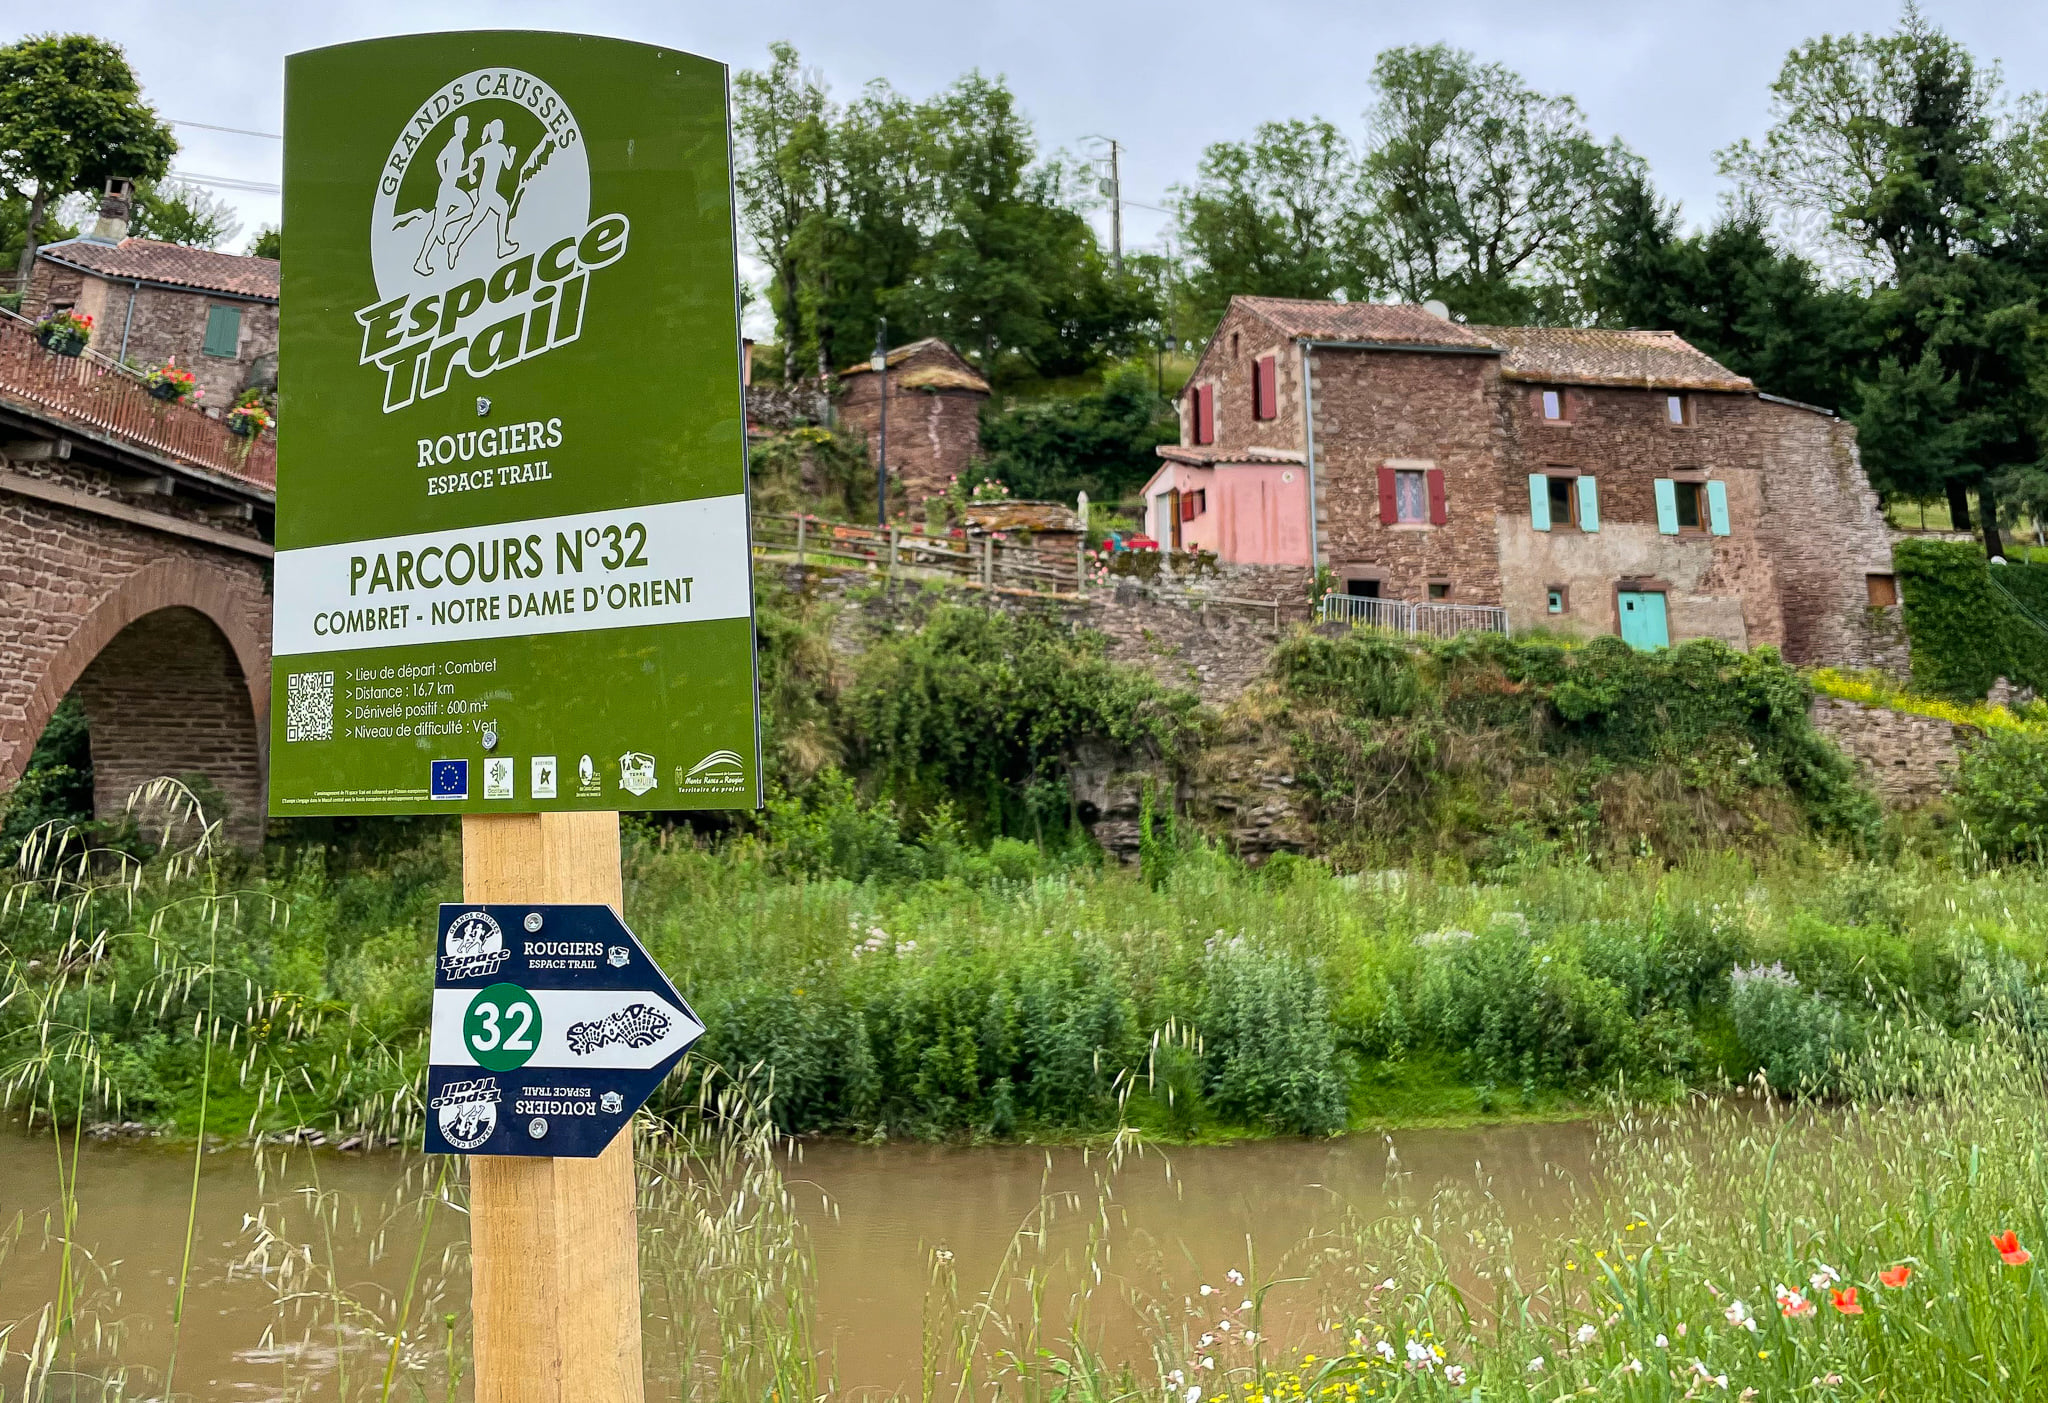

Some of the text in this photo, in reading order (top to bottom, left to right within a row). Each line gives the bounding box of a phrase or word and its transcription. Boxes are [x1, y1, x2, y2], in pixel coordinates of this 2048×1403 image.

[382, 74, 577, 195] GRANDS CAUSSES
[356, 216, 628, 362] Espace
[376, 273, 586, 411] Trail
[416, 417, 563, 468] ROUGIERS
[427, 461, 553, 496] ESPACE TRAIL
[349, 534, 543, 596] PARCOURS
[313, 604, 410, 636] COMBRET
[431, 596, 500, 626] NOTRE
[508, 588, 575, 619] DAME
[583, 577, 693, 612] D'ORIENT
[355, 667, 377, 681] Lieu
[380, 666, 395, 679] de
[397, 663, 436, 680] départ
[444, 658, 497, 675] Combret
[355, 686, 403, 701] Distance
[412, 682, 434, 698] 16,7
[437, 681, 455, 696] km
[355, 703, 403, 720] Dénivelé
[405, 701, 438, 719] positif
[447, 700, 467, 715] 600
[469, 702, 489, 713] m+
[354, 725, 393, 739] Niveau
[396, 723, 411, 737] de
[414, 722, 463, 737] difficulté
[472, 718, 498, 733] Vert
[449, 912, 474, 934] GRANDS
[441, 950, 510, 968] Espace
[523, 942, 604, 956] ROUGIERS
[446, 960, 500, 980] Trail
[529, 959, 597, 969] ESPACE TRAIL
[471, 1001, 534, 1051] 32
[442, 1077, 496, 1098] Trail
[522, 1086, 591, 1097] ESPACE TRAIL
[431, 1090, 501, 1108] Espace
[515, 1101, 597, 1116] ROUGIERS
